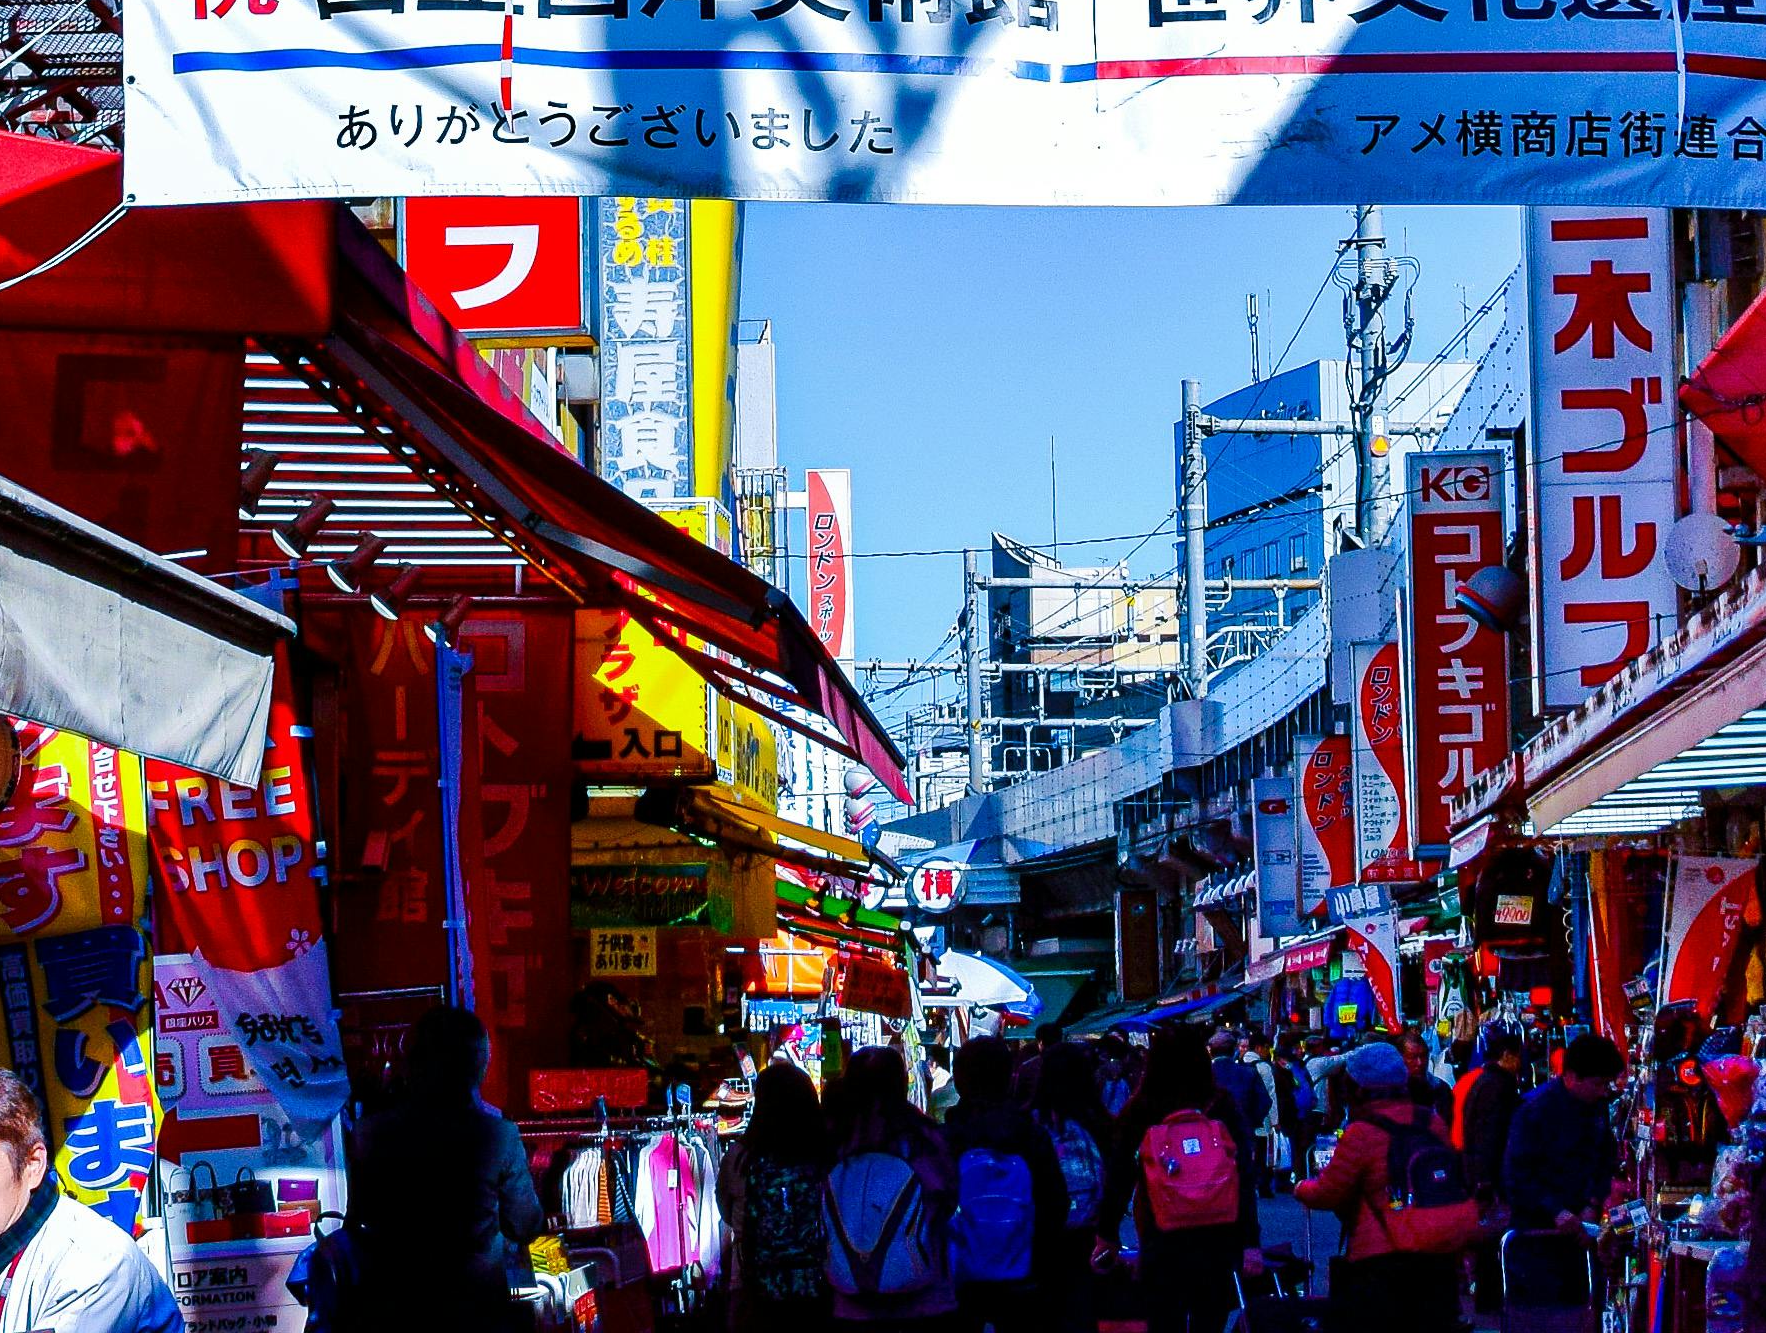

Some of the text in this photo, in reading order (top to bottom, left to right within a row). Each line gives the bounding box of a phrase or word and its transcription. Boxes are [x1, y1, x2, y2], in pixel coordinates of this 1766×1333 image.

[337, 99, 896, 155] ありがとうございました
[620, 730, 683, 759] 入口
[146, 764, 295, 825] FREE
[157, 832, 304, 893] SHOP
